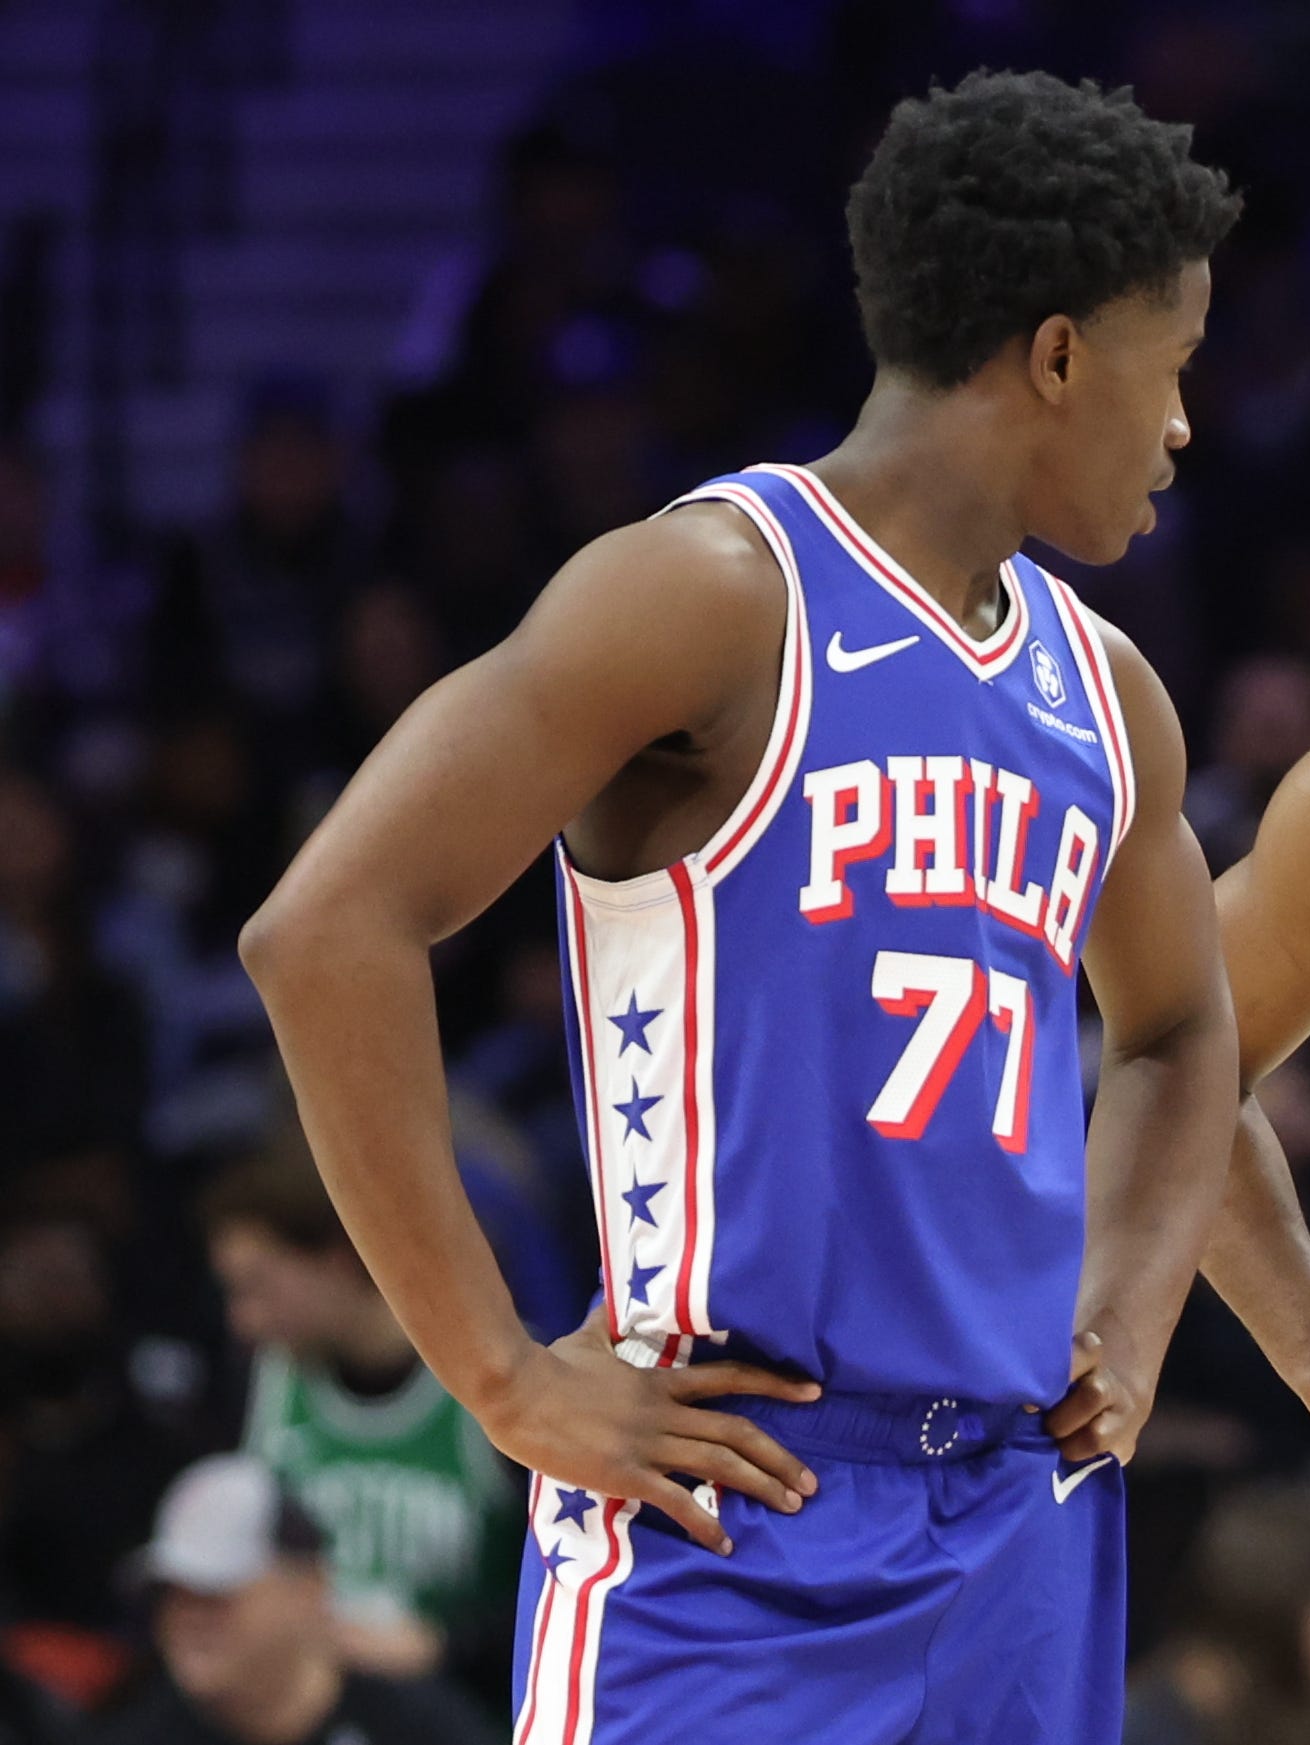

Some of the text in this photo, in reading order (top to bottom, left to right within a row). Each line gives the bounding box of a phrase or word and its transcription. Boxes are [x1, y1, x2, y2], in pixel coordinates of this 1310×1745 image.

[1026, 702, 1097, 743] crypto.com
[799, 755, 1099, 977] PHILA
[866, 950, 1035, 1154] 77
